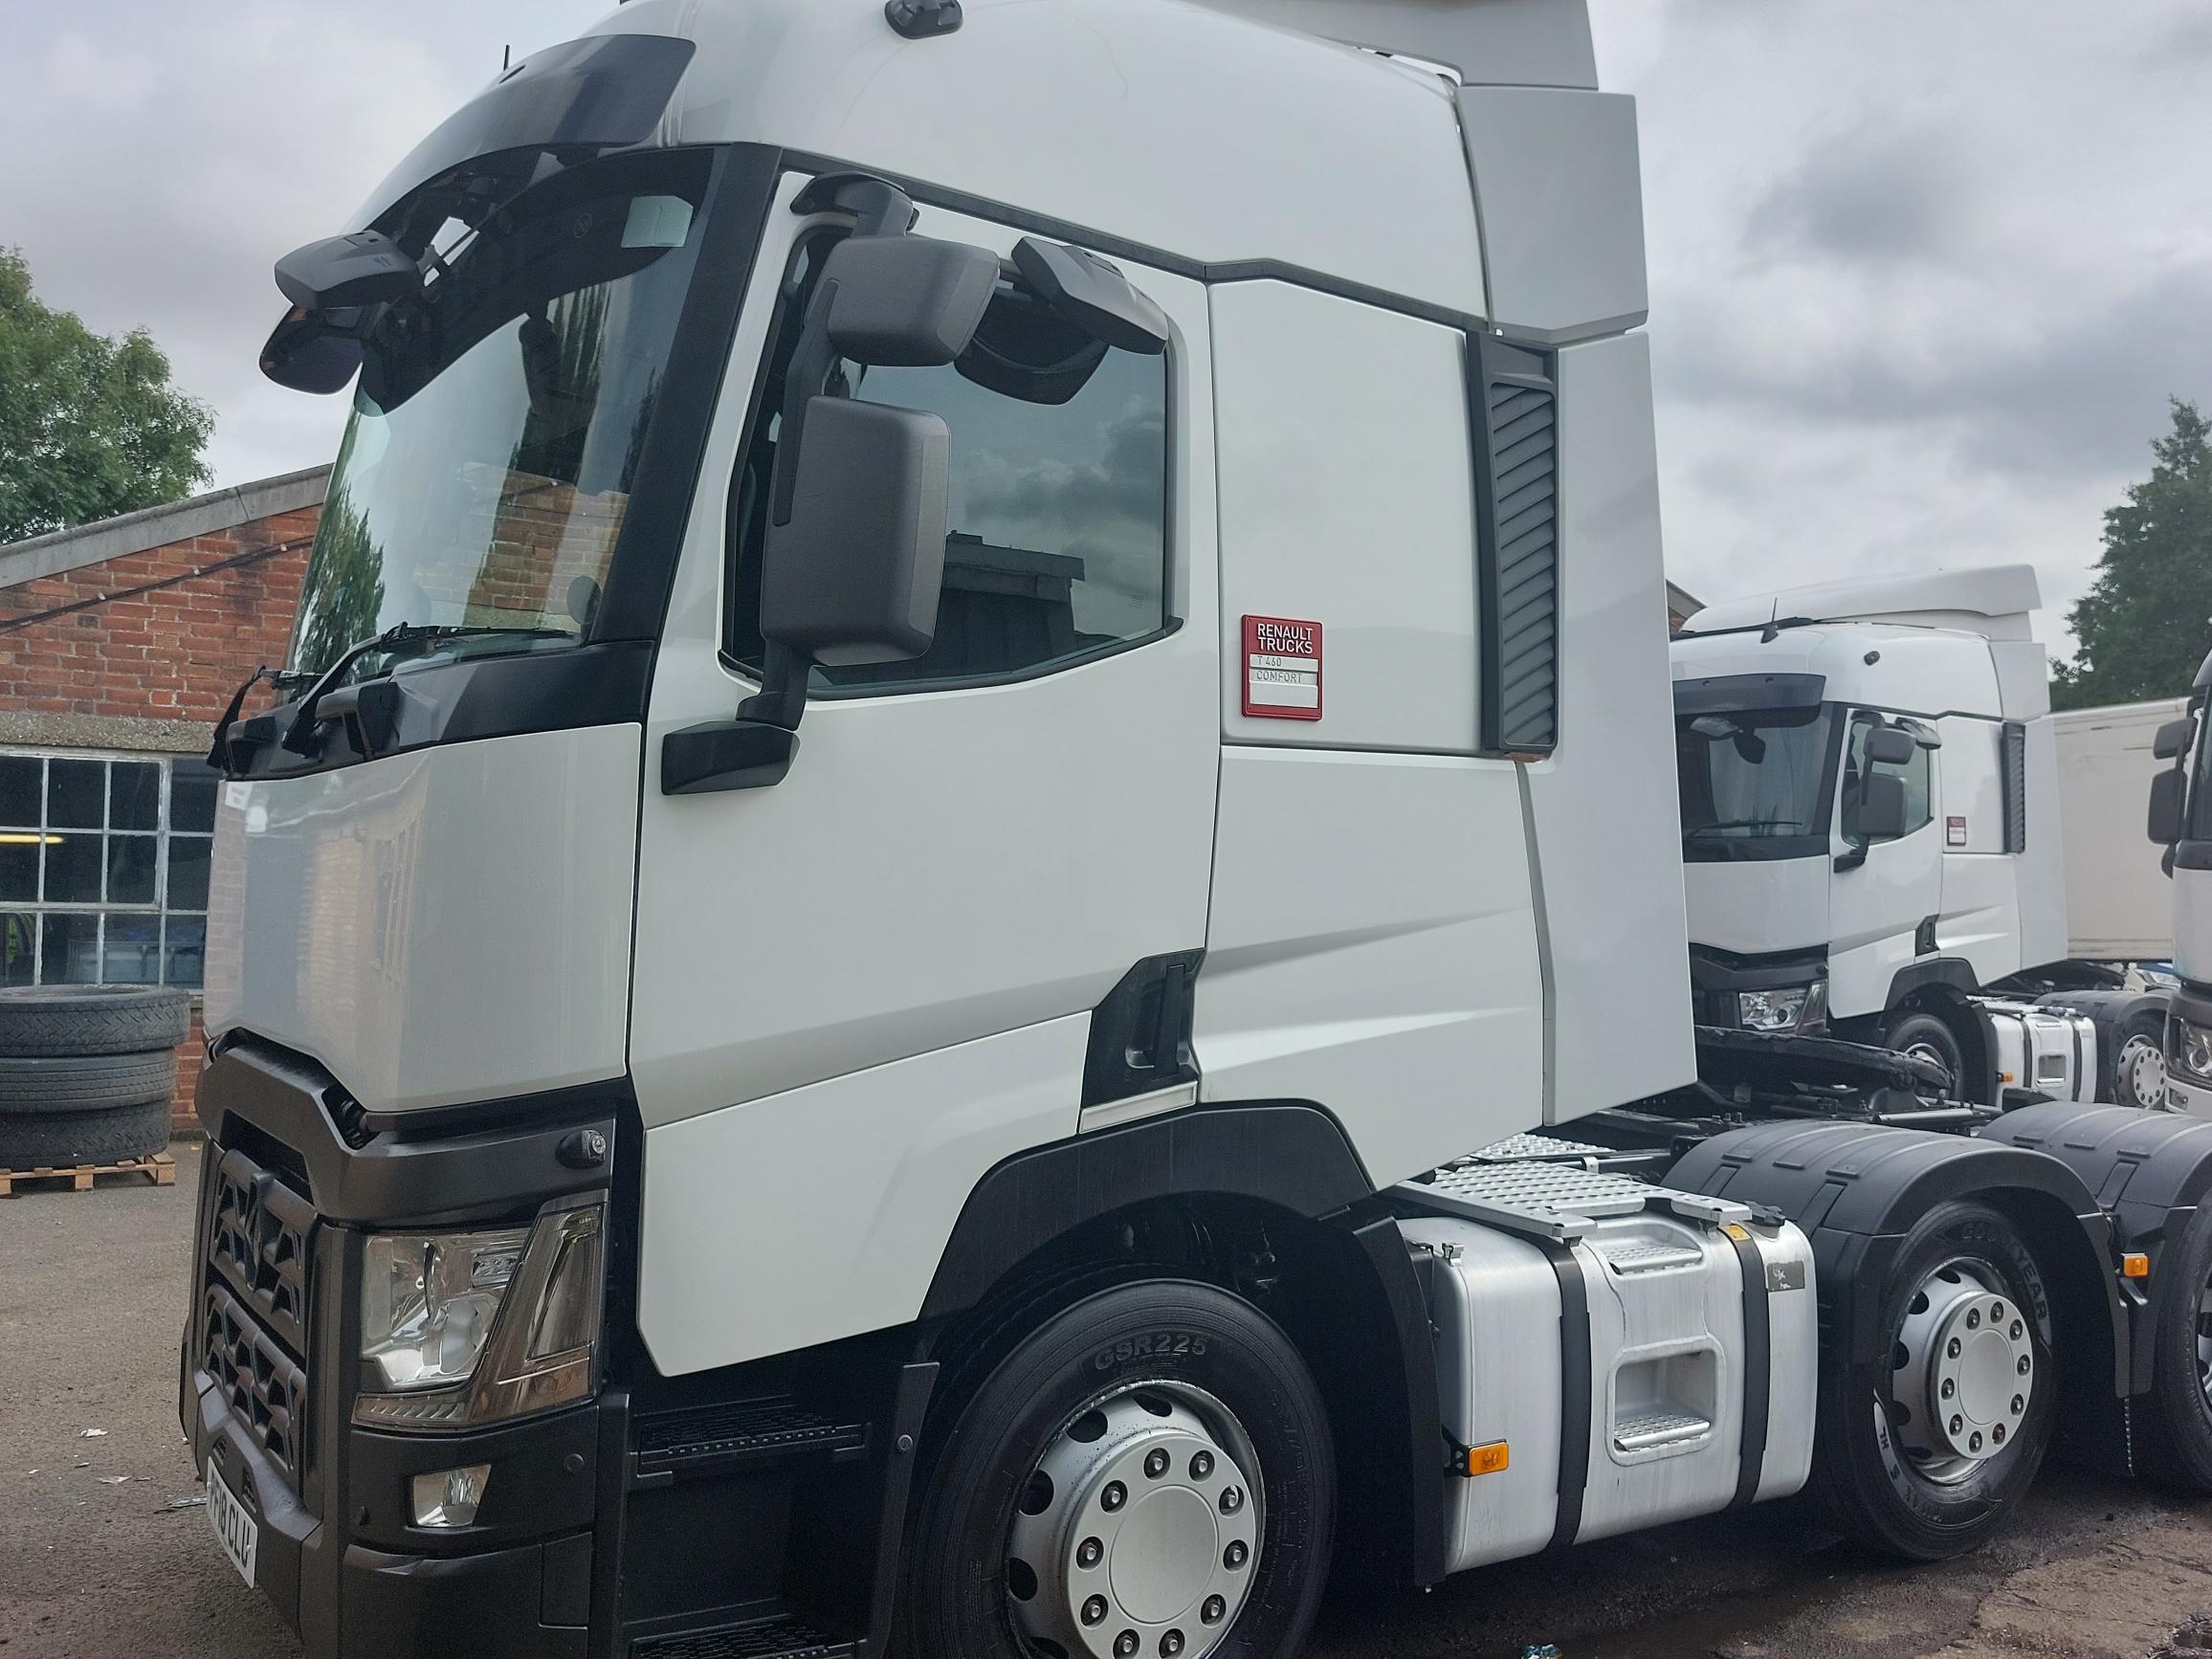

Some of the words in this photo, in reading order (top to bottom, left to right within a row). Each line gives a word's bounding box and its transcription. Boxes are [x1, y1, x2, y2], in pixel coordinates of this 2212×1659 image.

[1257, 623, 1314, 640] RENAULT
[1257, 636, 1314, 653] TRUCKS
[1257, 655, 1264, 666] T
[1266, 656, 1282, 667] 460
[1256, 670, 1302, 683] COMFORT
[1961, 1223, 2047, 1320] GOYEAR
[1094, 1332, 1207, 1370] GSR225
[228, 1502, 251, 1569] CLU
